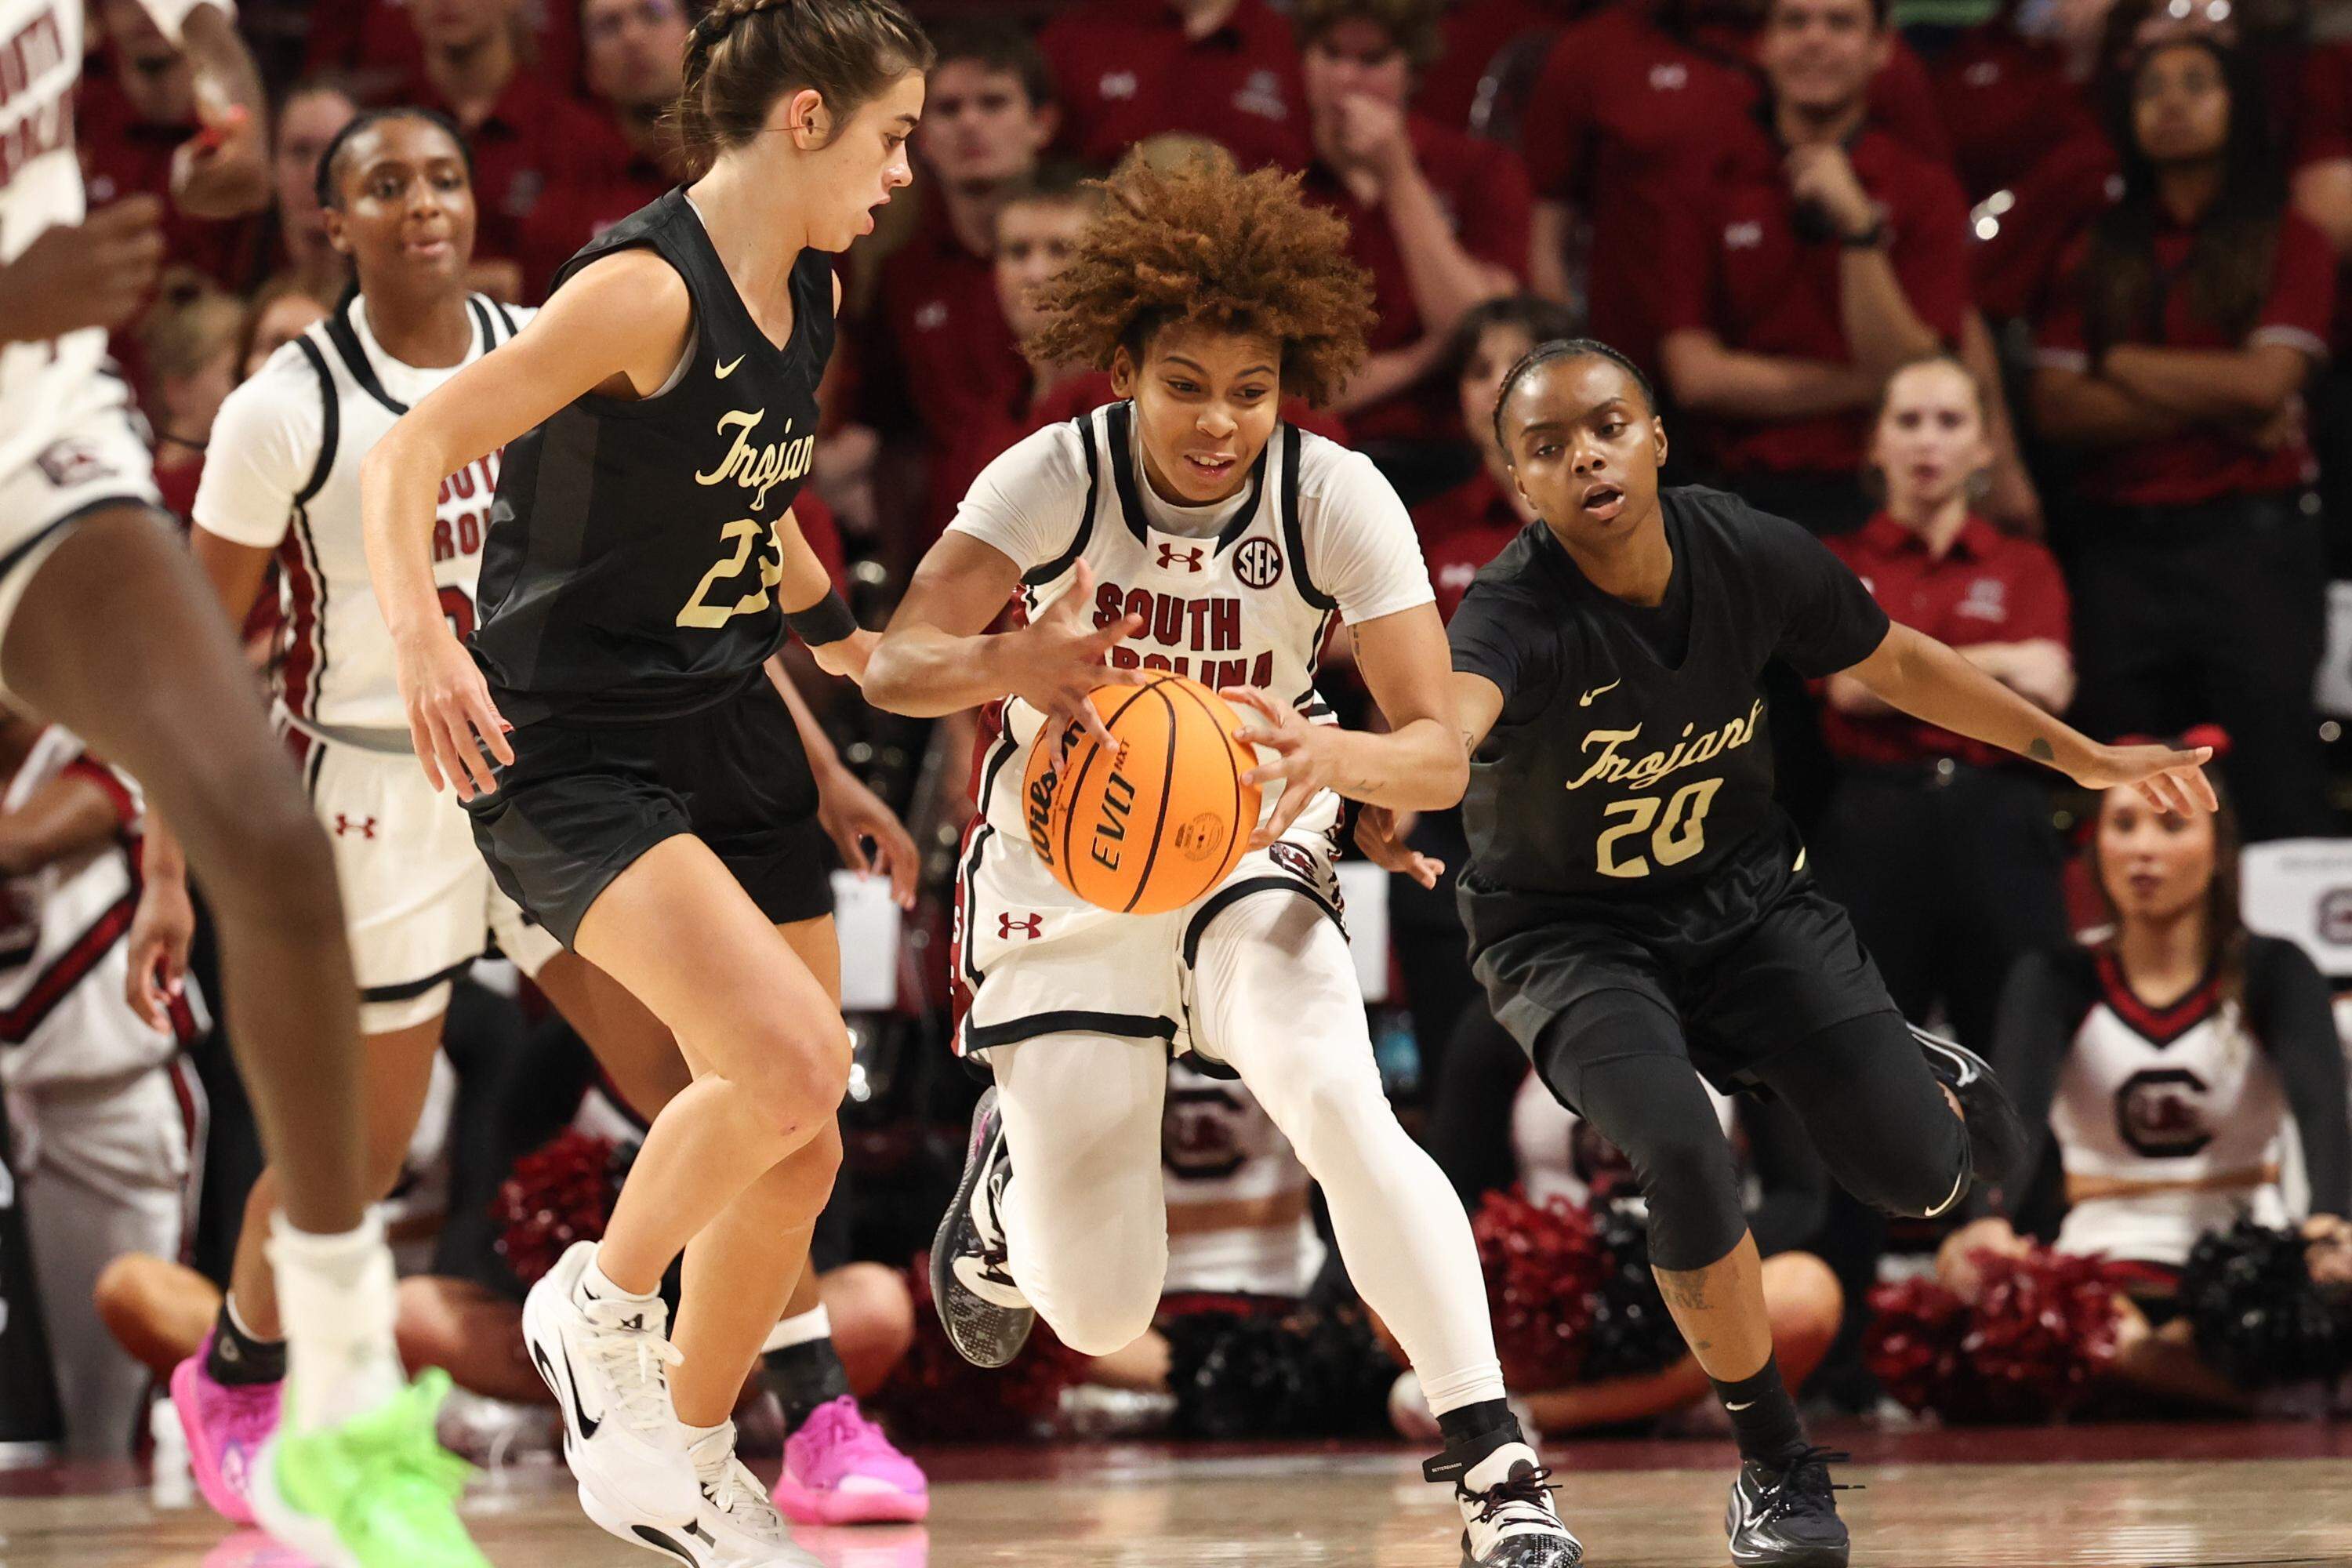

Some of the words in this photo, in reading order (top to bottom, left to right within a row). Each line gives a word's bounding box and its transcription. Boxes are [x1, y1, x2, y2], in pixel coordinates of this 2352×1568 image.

[1237, 541, 1279, 586] SEC
[1093, 582, 1240, 652] SOUTH
[1566, 698, 1764, 790] Trojans
[1029, 720, 1087, 866] Wilsn
[1091, 771, 1135, 871] EVO
[1596, 778, 1723, 878] 20
